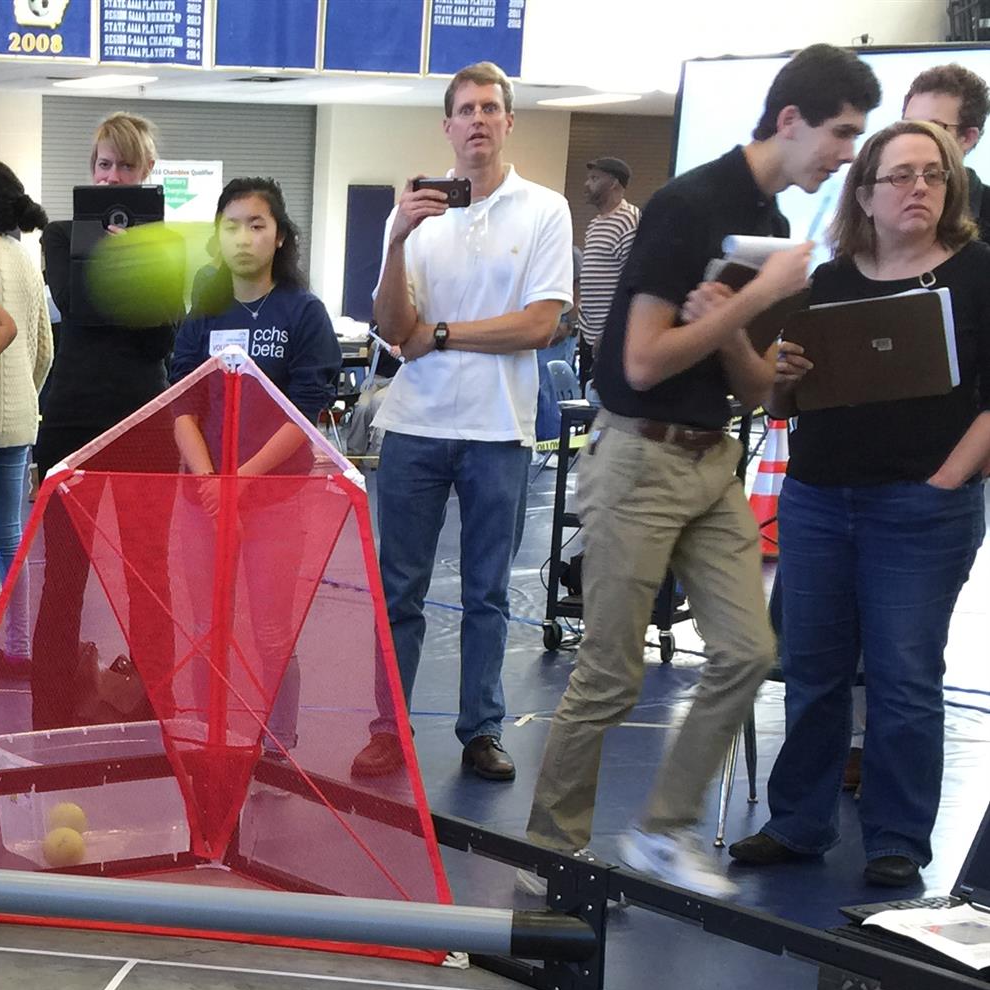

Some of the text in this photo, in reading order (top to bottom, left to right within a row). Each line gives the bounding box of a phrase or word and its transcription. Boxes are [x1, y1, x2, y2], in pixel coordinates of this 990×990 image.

[104, 0, 126, 8] STATE
[142, 1, 175, 11] PLAYOFFS
[434, 5, 452, 15] STATE
[469, 7, 495, 17] PLAYOFFS
[434, 15, 452, 25] STATE
[468, 17, 495, 27] PLAYOFFS
[104, 22, 126, 32] STATE
[142, 24, 175, 34] PLAYOFFS
[8, 32, 64, 54] 2008
[104, 46, 126, 56] STATE
[142, 47, 175, 58] PLAYOFFS
[191, 168, 214, 176] Qualifier
[253, 326, 289, 343] cchs
[250, 341, 285, 359] beta
